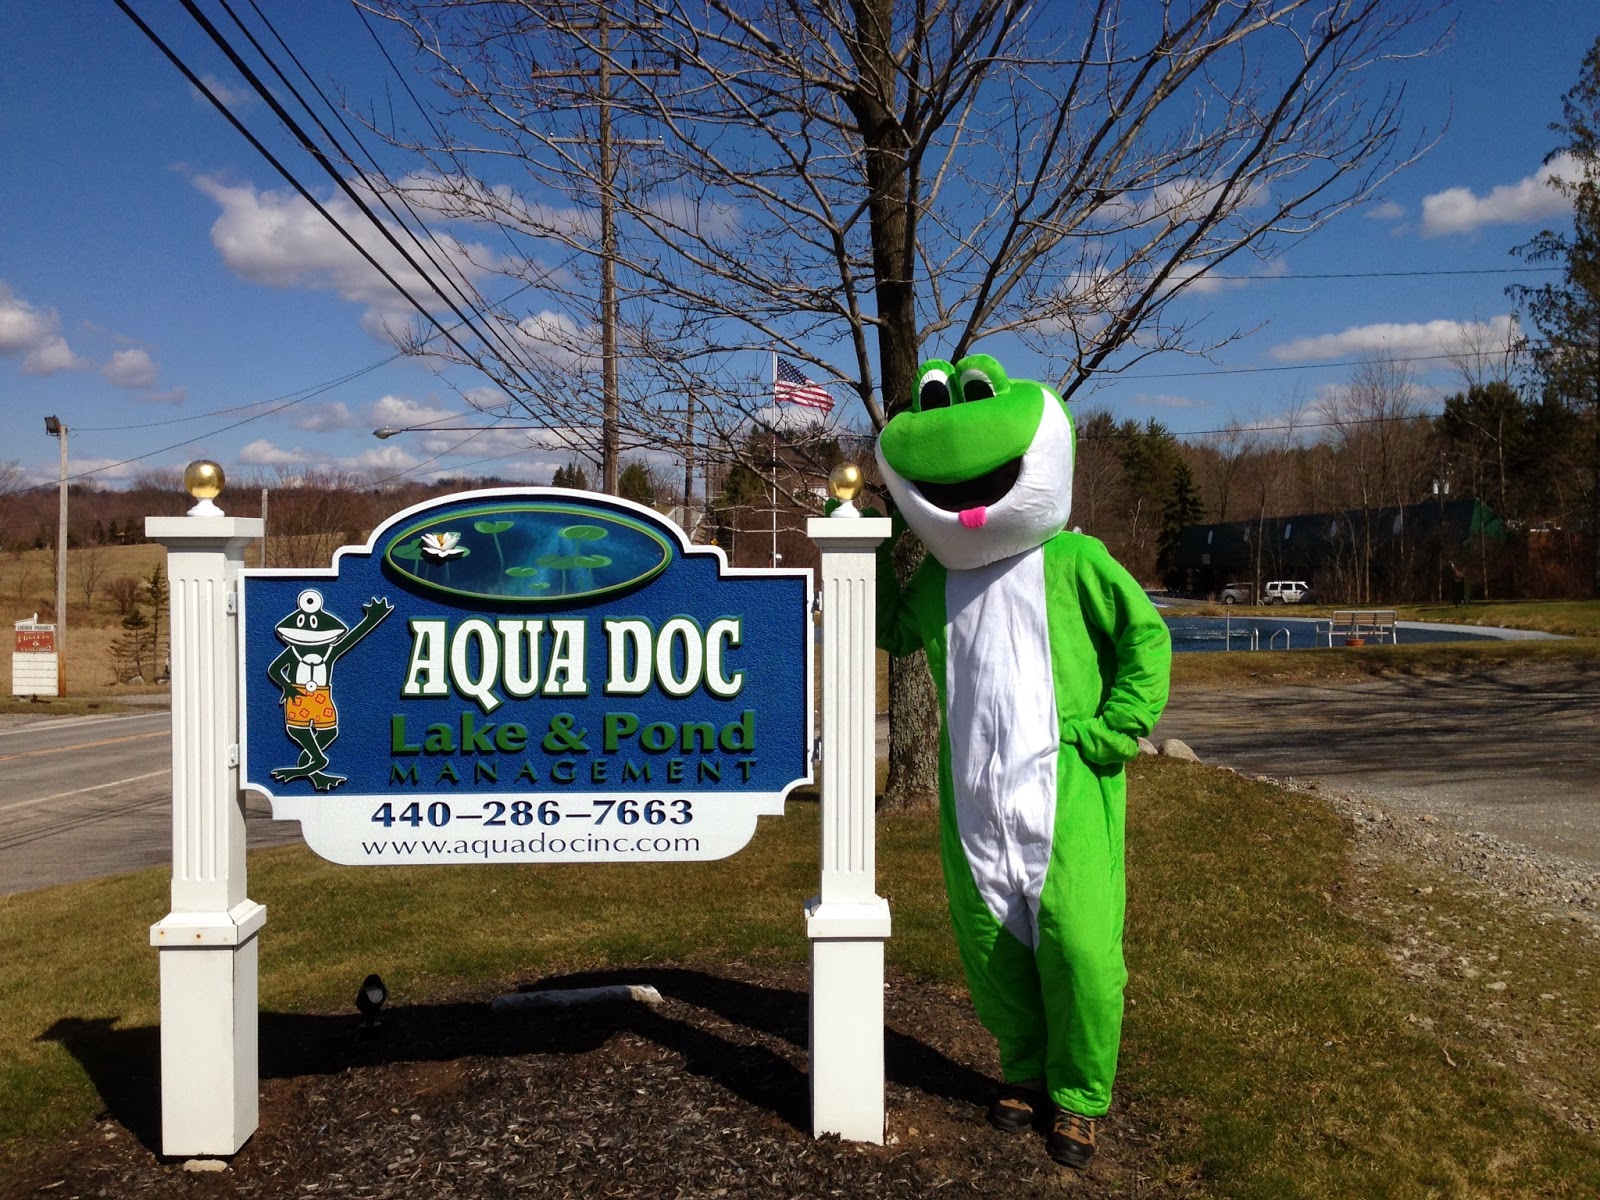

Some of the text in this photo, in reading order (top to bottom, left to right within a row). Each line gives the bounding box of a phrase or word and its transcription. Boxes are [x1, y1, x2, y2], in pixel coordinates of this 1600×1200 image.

[402, 614, 746, 713] AQUA DOC
[391, 708, 757, 752] Lake & Pond
[389, 756, 759, 785] MANAGEMENT
[361, 832, 701, 859] www.aquadocinc.com
